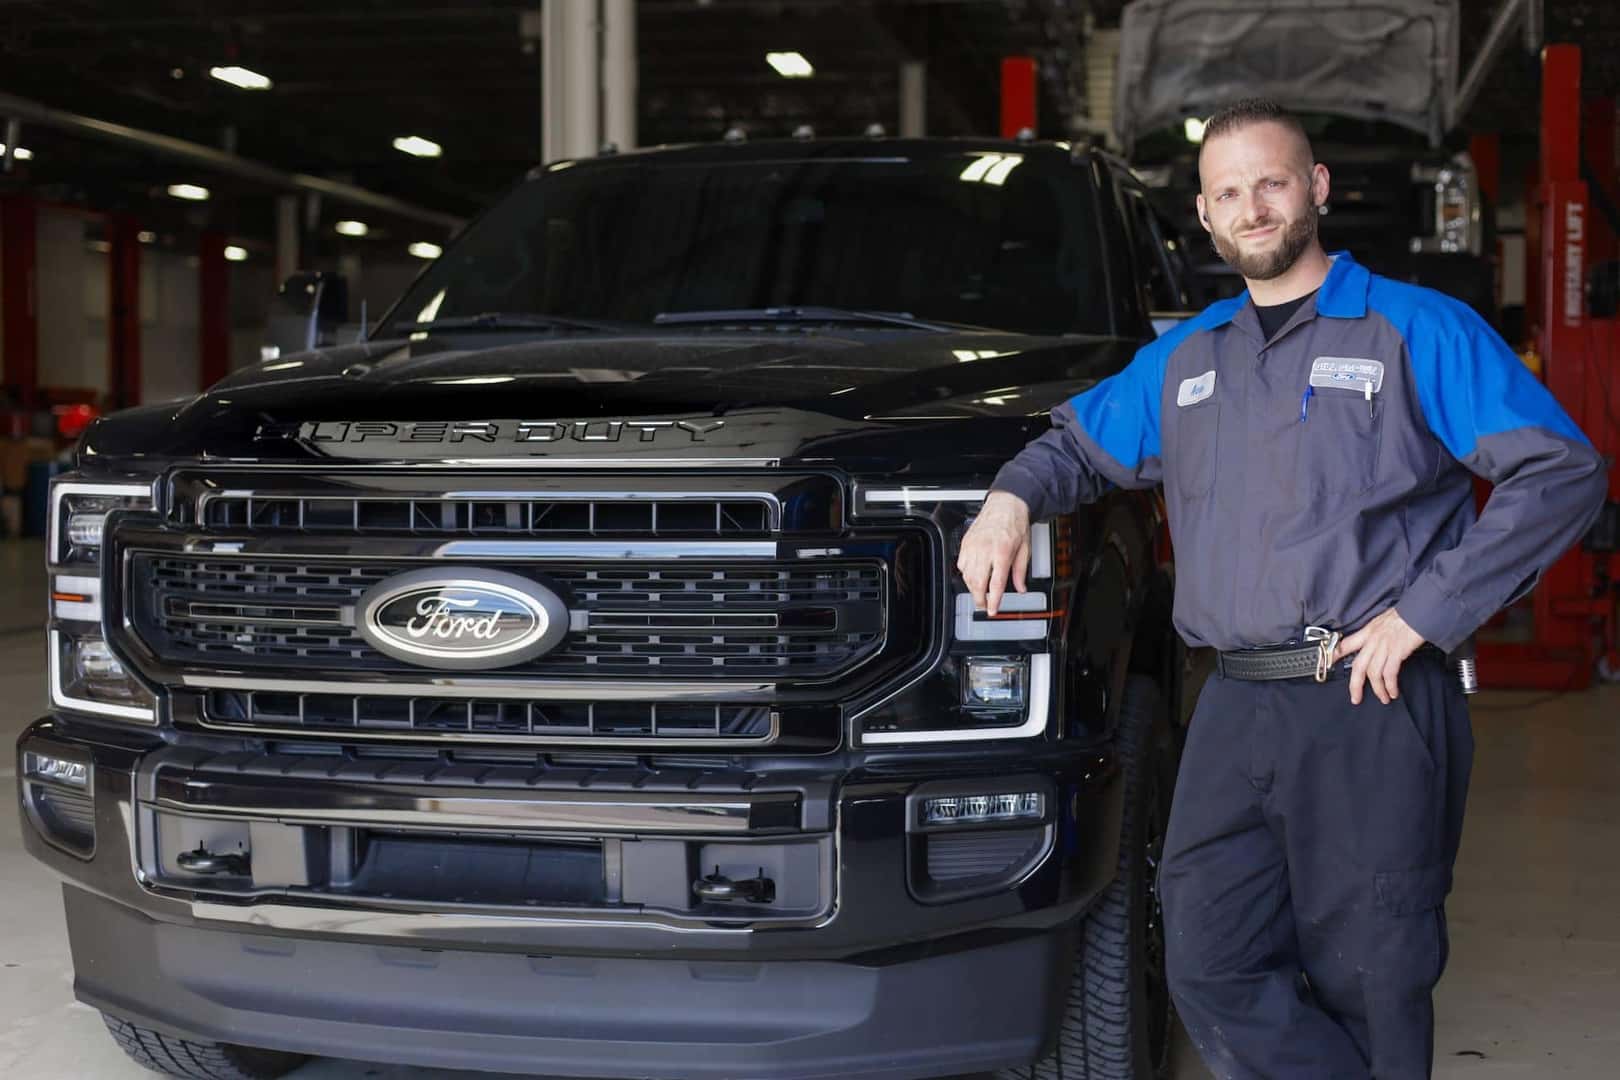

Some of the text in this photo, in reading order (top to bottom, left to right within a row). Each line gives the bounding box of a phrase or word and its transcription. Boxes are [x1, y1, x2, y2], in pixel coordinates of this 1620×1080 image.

[1566, 202, 1584, 240] LIFT
[514, 420, 725, 443] DUTY
[406, 596, 501, 639] Ford
